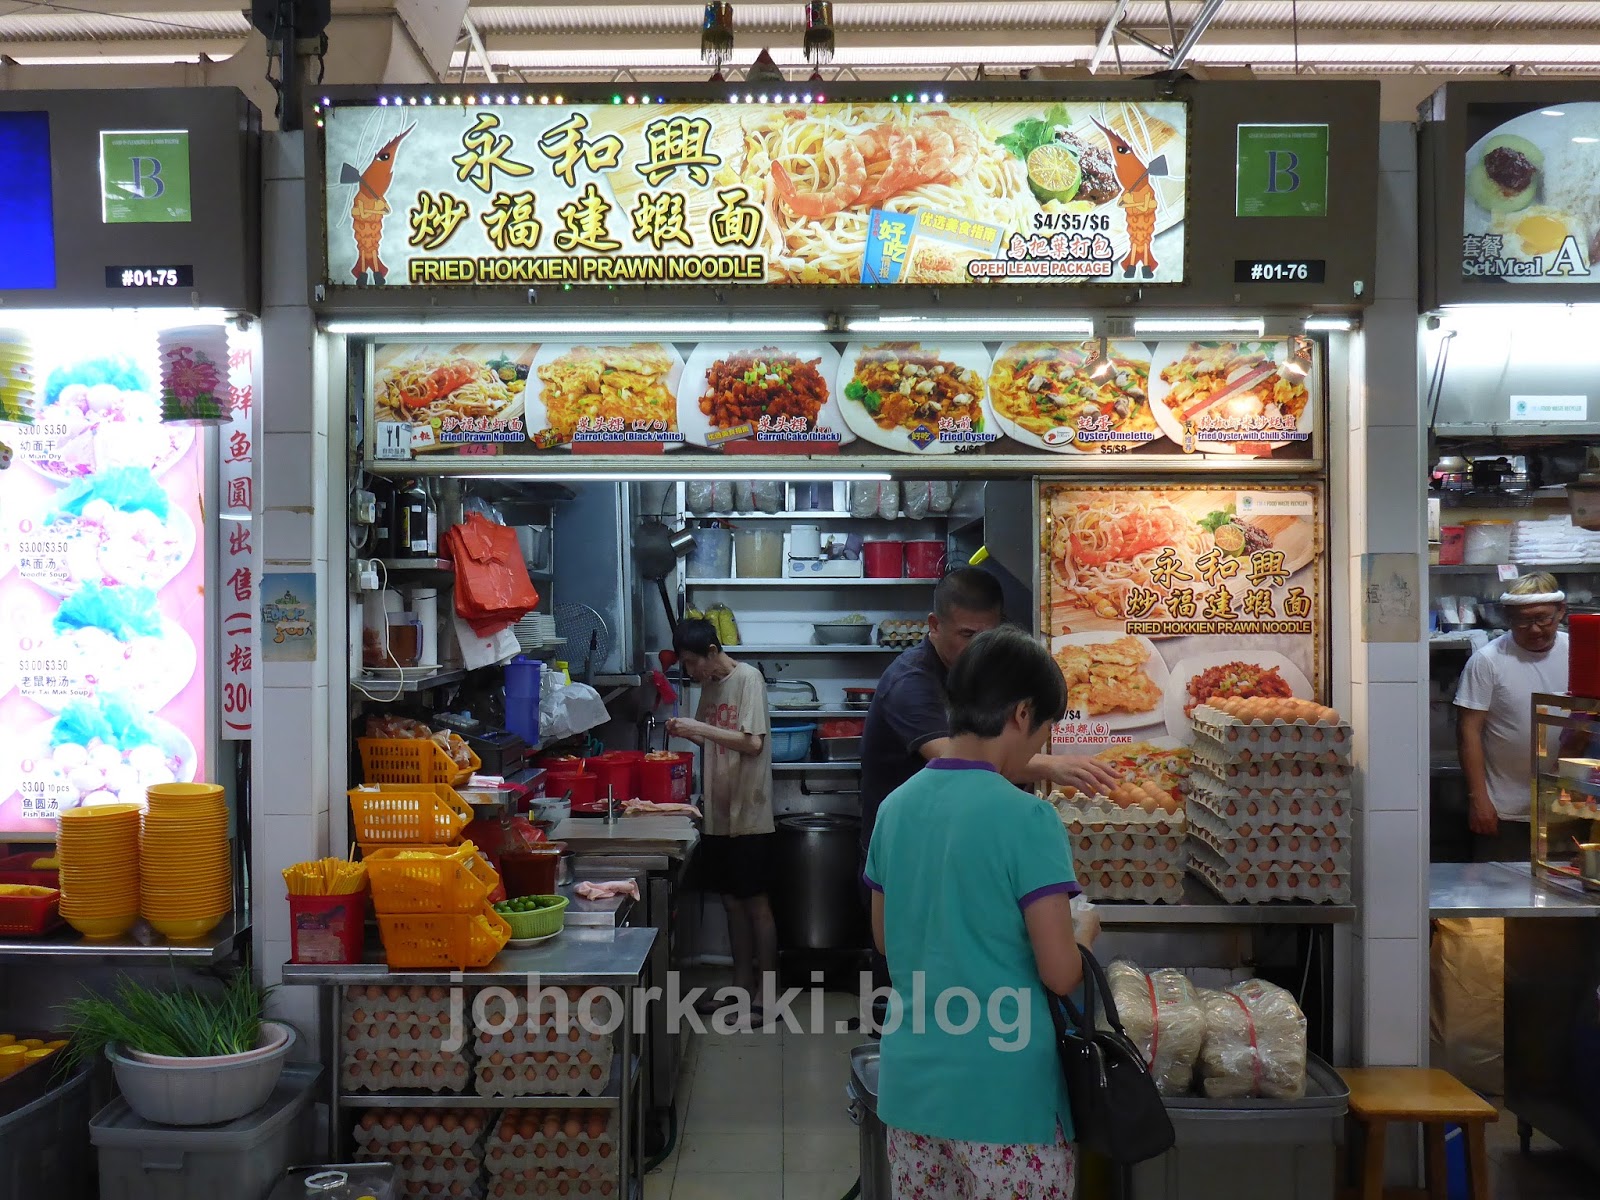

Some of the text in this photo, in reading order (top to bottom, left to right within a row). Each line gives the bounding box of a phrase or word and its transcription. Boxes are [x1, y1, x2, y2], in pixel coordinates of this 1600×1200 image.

[452, 113, 721, 192] 永和興
[128, 156, 165, 199] B
[1264, 150, 1300, 193] B
[409, 185, 763, 251] 炒福建蝦面
[1034, 212, 1110, 231] $4/$5/$6
[1463, 235, 1502, 257] 套餐
[1462, 236, 1590, 276] Set Meal A
[411, 256, 762, 282] FRIED HOKKIEN PRAWN NOODLE
[970, 262, 1110, 275] OPEH LEAVE PACKAGE
[1250, 264, 1308, 280] #01-76
[122, 269, 178, 286] #01-75
[440, 432, 463, 442] Fried
[464, 432, 492, 442] Prawn
[493, 432, 525, 442] Noodle
[574, 432, 601, 441] Carrot
[602, 432, 624, 441] Cake
[757, 432, 785, 441] Carrot
[786, 432, 808, 441] Cake
[939, 432, 996, 443] Fried Oyster
[1078, 431, 1109, 441] Oyster
[1110, 431, 1154, 441] Omelette
[1198, 431, 1308, 441] Fried Oyster with Chilli Shrimp
[1150, 548, 1290, 588] 永和興
[1126, 586, 1312, 619] 炒福建蝦面
[1126, 622, 1311, 634] FRIED HOKKIEN PRAWN NOODLE
[22, 781, 45, 792] $3.00
